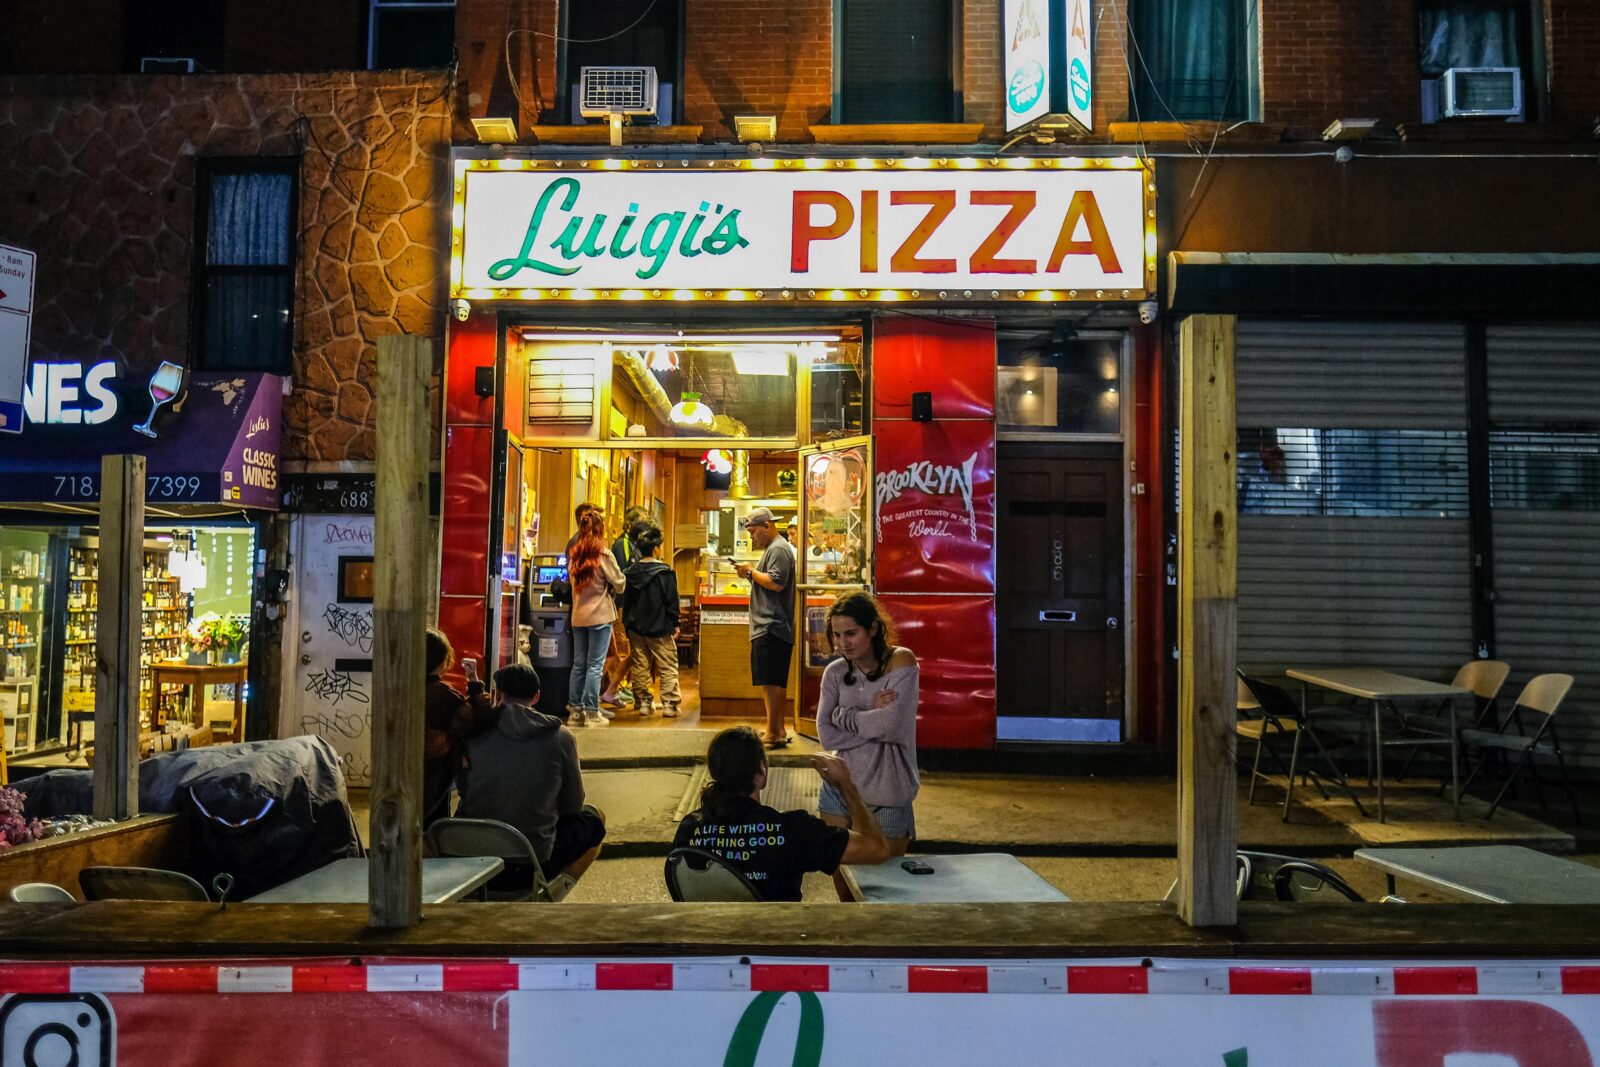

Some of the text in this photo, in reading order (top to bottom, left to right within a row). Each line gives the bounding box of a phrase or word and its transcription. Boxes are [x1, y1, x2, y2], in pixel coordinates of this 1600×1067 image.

[487, 177, 1123, 280] Luigi's PIZZA
[7, 255, 23, 266] 8am
[0, 265, 25, 280] Sunday
[243, 447, 276, 469] CLASSIC
[148, 476, 201, 497] 7399
[243, 465, 277, 490] WINES
[876, 452, 978, 514] BROOKLYN
[340, 491, 368, 508] 688
[882, 508, 970, 526] THE GREATEST COUNTRY IN THE
[694, 823, 782, 836] A LIFE WITHOUT
[689, 835, 785, 847] ANYTHING GOOD
